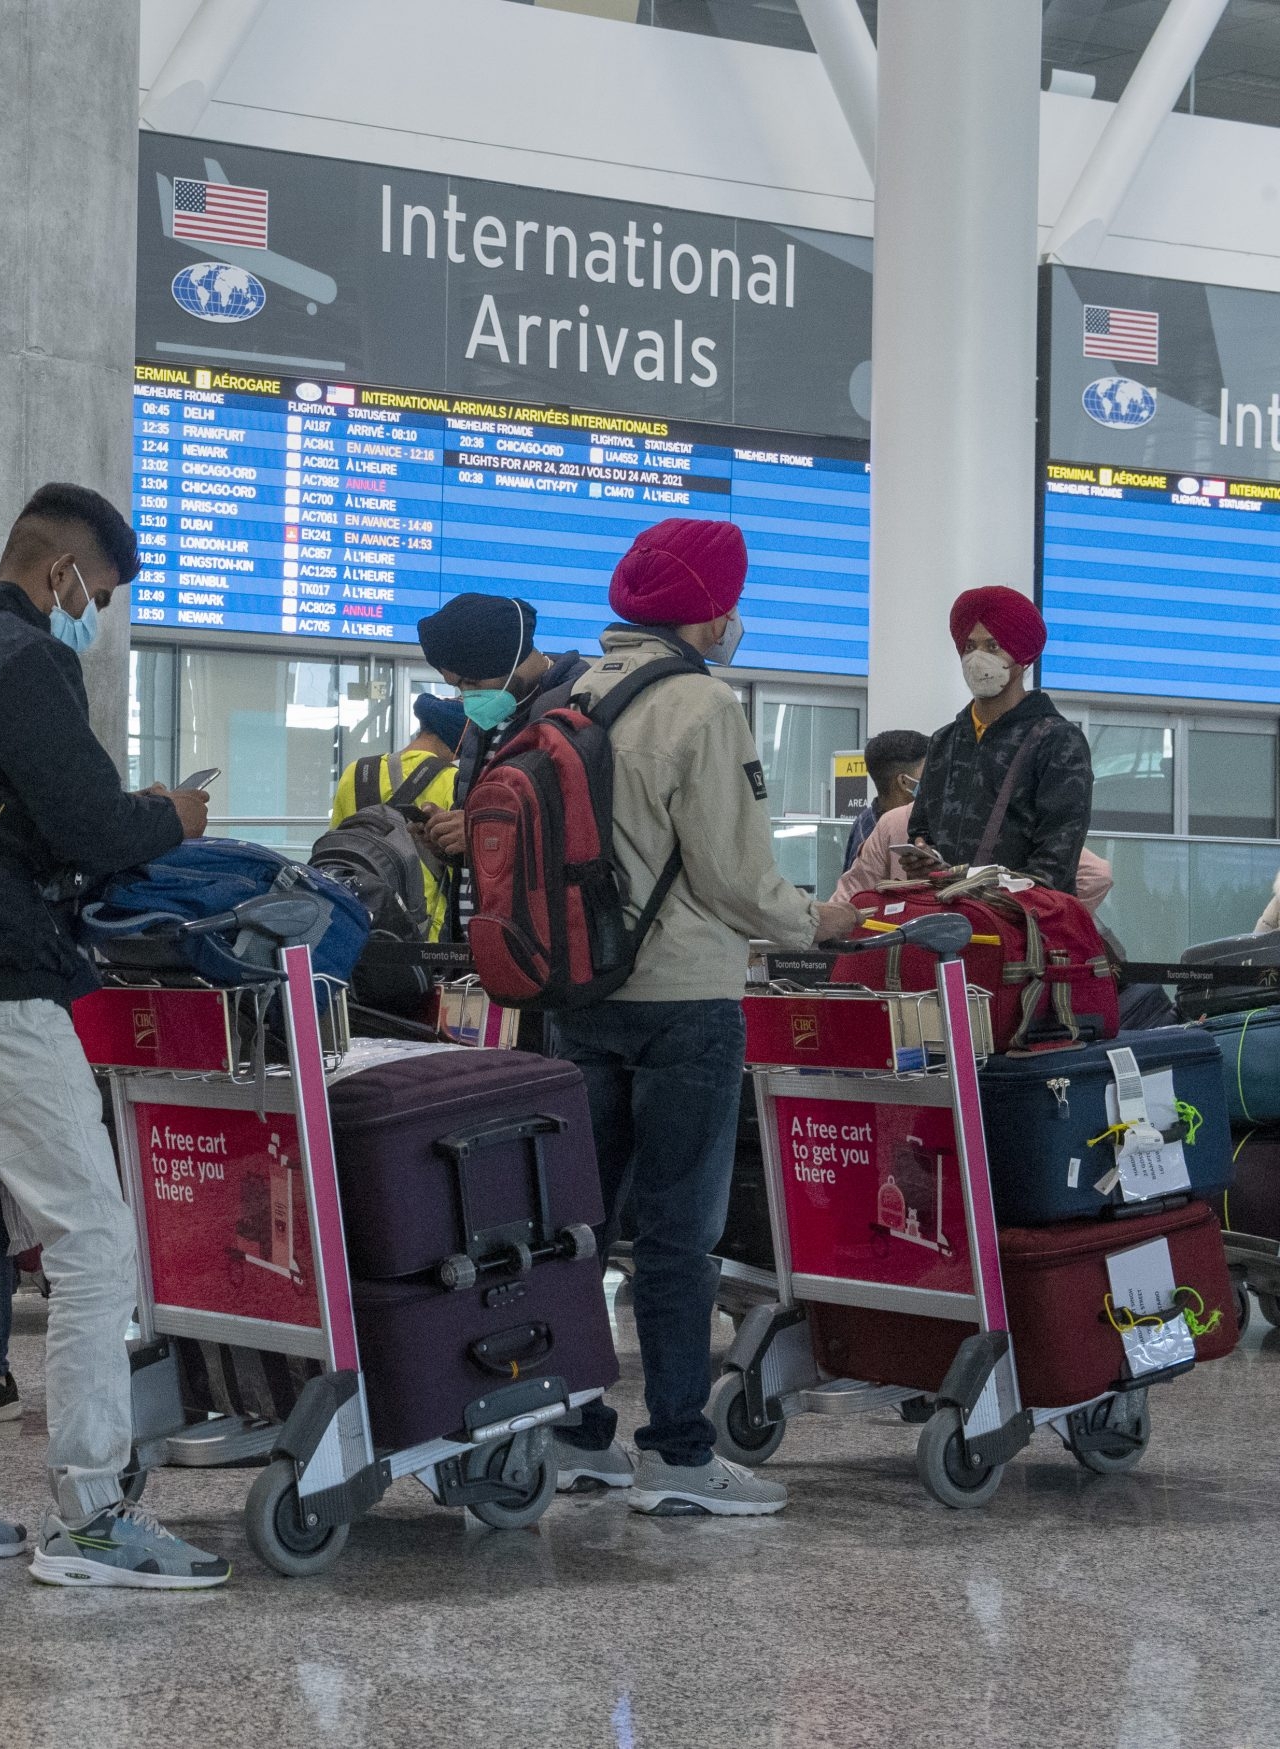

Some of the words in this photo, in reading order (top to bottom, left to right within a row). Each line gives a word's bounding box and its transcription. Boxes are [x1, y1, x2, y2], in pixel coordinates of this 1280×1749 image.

[381, 184, 795, 308] International
[465, 294, 718, 388] Arrivals
[134, 385, 182, 400] IME/HEURE
[184, 391, 224, 404] FROM/DE
[213, 373, 281, 394] AÉROGARE
[143, 402, 170, 416] 08:45
[183, 406, 215, 421] DELHI
[304, 420, 331, 433] AI187
[347, 424, 384, 439] ARRIVÉ
[392, 428, 417, 442] 08:10
[288, 401, 337, 416] FLIGHT/VOL
[348, 407, 401, 422] STATUS/ÉTAT
[361, 391, 450, 413] INTERNATIONAL
[452, 401, 507, 419] ARRIVALS
[508, 407, 513, 418] /
[514, 409, 569, 426] ARRIVÉES
[571, 414, 668, 436] INTERNATIONALES
[142, 421, 170, 435] 12:35
[183, 425, 246, 442] FRANKFURT
[347, 442, 361, 453] EN
[363, 443, 402, 458] AVANCE
[447, 418, 495, 433] TIME/HEURE
[497, 423, 534, 438] FROM/DE
[142, 440, 169, 453] 12:44
[182, 444, 228, 459] NEWARK
[303, 456, 339, 470] AC8021
[346, 458, 356, 471] À
[356, 461, 397, 476] L'HEURE
[460, 436, 484, 449] 20:36
[497, 439, 564, 457] CHICAGO-ORD
[606, 451, 638, 464] UA4552
[644, 453, 652, 466] À
[653, 457, 691, 470] L'HEURE
[591, 433, 635, 448] FLIGHT/VOL
[645, 439, 693, 454] STATUS/ÉTAT
[141, 458, 169, 472] 13:02
[182, 462, 257, 480] CHICAGO-ORD
[302, 474, 339, 488] AC7982
[345, 478, 387, 492] ANNULÉ
[459, 453, 499, 468] FLIGHTS
[501, 458, 521, 470] FOR
[523, 460, 542, 472] APR
[544, 462, 557, 475] 24,
[559, 464, 580, 476] 2021
[581, 466, 586, 476] /
[586, 467, 611, 479] VOLS
[613, 469, 627, 480] DU
[628, 470, 639, 481] 24
[640, 472, 660, 484] AVR.
[662, 474, 683, 487] 2021
[1047, 465, 1096, 482] TERMINAL
[1113, 471, 1167, 489] AÉROGARE
[141, 477, 168, 490] 13:04
[181, 481, 256, 498] CHICAGO-ORD
[302, 492, 333, 505] AC700
[345, 493, 355, 507] À
[355, 497, 397, 512] L'HEURE
[458, 471, 484, 484] 00:38
[495, 474, 535, 489] PANAMA
[536, 479, 578, 493] CITY-PTY
[604, 485, 634, 498] CM470
[643, 487, 651, 500] À
[651, 491, 690, 505] L'HEURE
[140, 495, 168, 509] 15:00
[181, 500, 238, 516] PARIS-CDG
[345, 515, 360, 526] EN
[361, 516, 400, 530] AVANCE
[408, 520, 433, 533] 14:49
[140, 514, 167, 528] 15:10
[180, 518, 213, 532] DUBAI
[302, 528, 331, 542] EK241
[345, 532, 359, 544] EN
[361, 533, 400, 548] AVANCE
[408, 538, 432, 550] 14:53
[139, 533, 166, 546] 16:45
[180, 537, 249, 553] LONDON-LHR
[344, 548, 353, 562] À
[353, 551, 396, 566] L'HEURE
[139, 552, 166, 565] 18:10
[179, 555, 254, 572] KINGSTON-KIN
[300, 565, 337, 579] AC1255
[343, 566, 353, 580] À
[353, 569, 395, 583] L'HEURE
[138, 571, 165, 584] 18:35
[179, 574, 229, 589] ISTANBUL
[300, 583, 330, 596] TK017
[343, 584, 352, 598] À
[352, 588, 394, 601] L'HEURE
[138, 589, 165, 602] 18:49
[178, 592, 224, 606] NEWARK
[342, 604, 383, 618] ANNULÉ
[137, 608, 164, 620] 18:50
[178, 611, 223, 625] NEWARK
[299, 619, 330, 632] AC705
[342, 620, 351, 634] À
[351, 624, 393, 637] L'HEURE
[846, 762, 867, 773] ATT
[421, 950, 449, 960] Toronto
[775, 960, 800, 969] Toronto
[801, 961, 827, 969] Pearson
[1167, 970, 1189, 979] Toronto
[1190, 971, 1214, 979] Pearson
[135, 1013, 154, 1027] CIBC
[794, 1018, 815, 1031] CIBC
[151, 1126, 162, 1148] A
[164, 1126, 194, 1151] free
[197, 1133, 227, 1155] cart
[791, 1116, 803, 1136] A
[806, 1116, 837, 1139] free
[841, 1123, 873, 1142] cart
[792, 1139, 808, 1159] to
[813, 1143, 837, 1165] get
[841, 1148, 869, 1167] you
[152, 1153, 167, 1174] to
[171, 1156, 194, 1181] get
[197, 1161, 224, 1183] you
[795, 1161, 836, 1184] there
[155, 1177, 194, 1202] there
